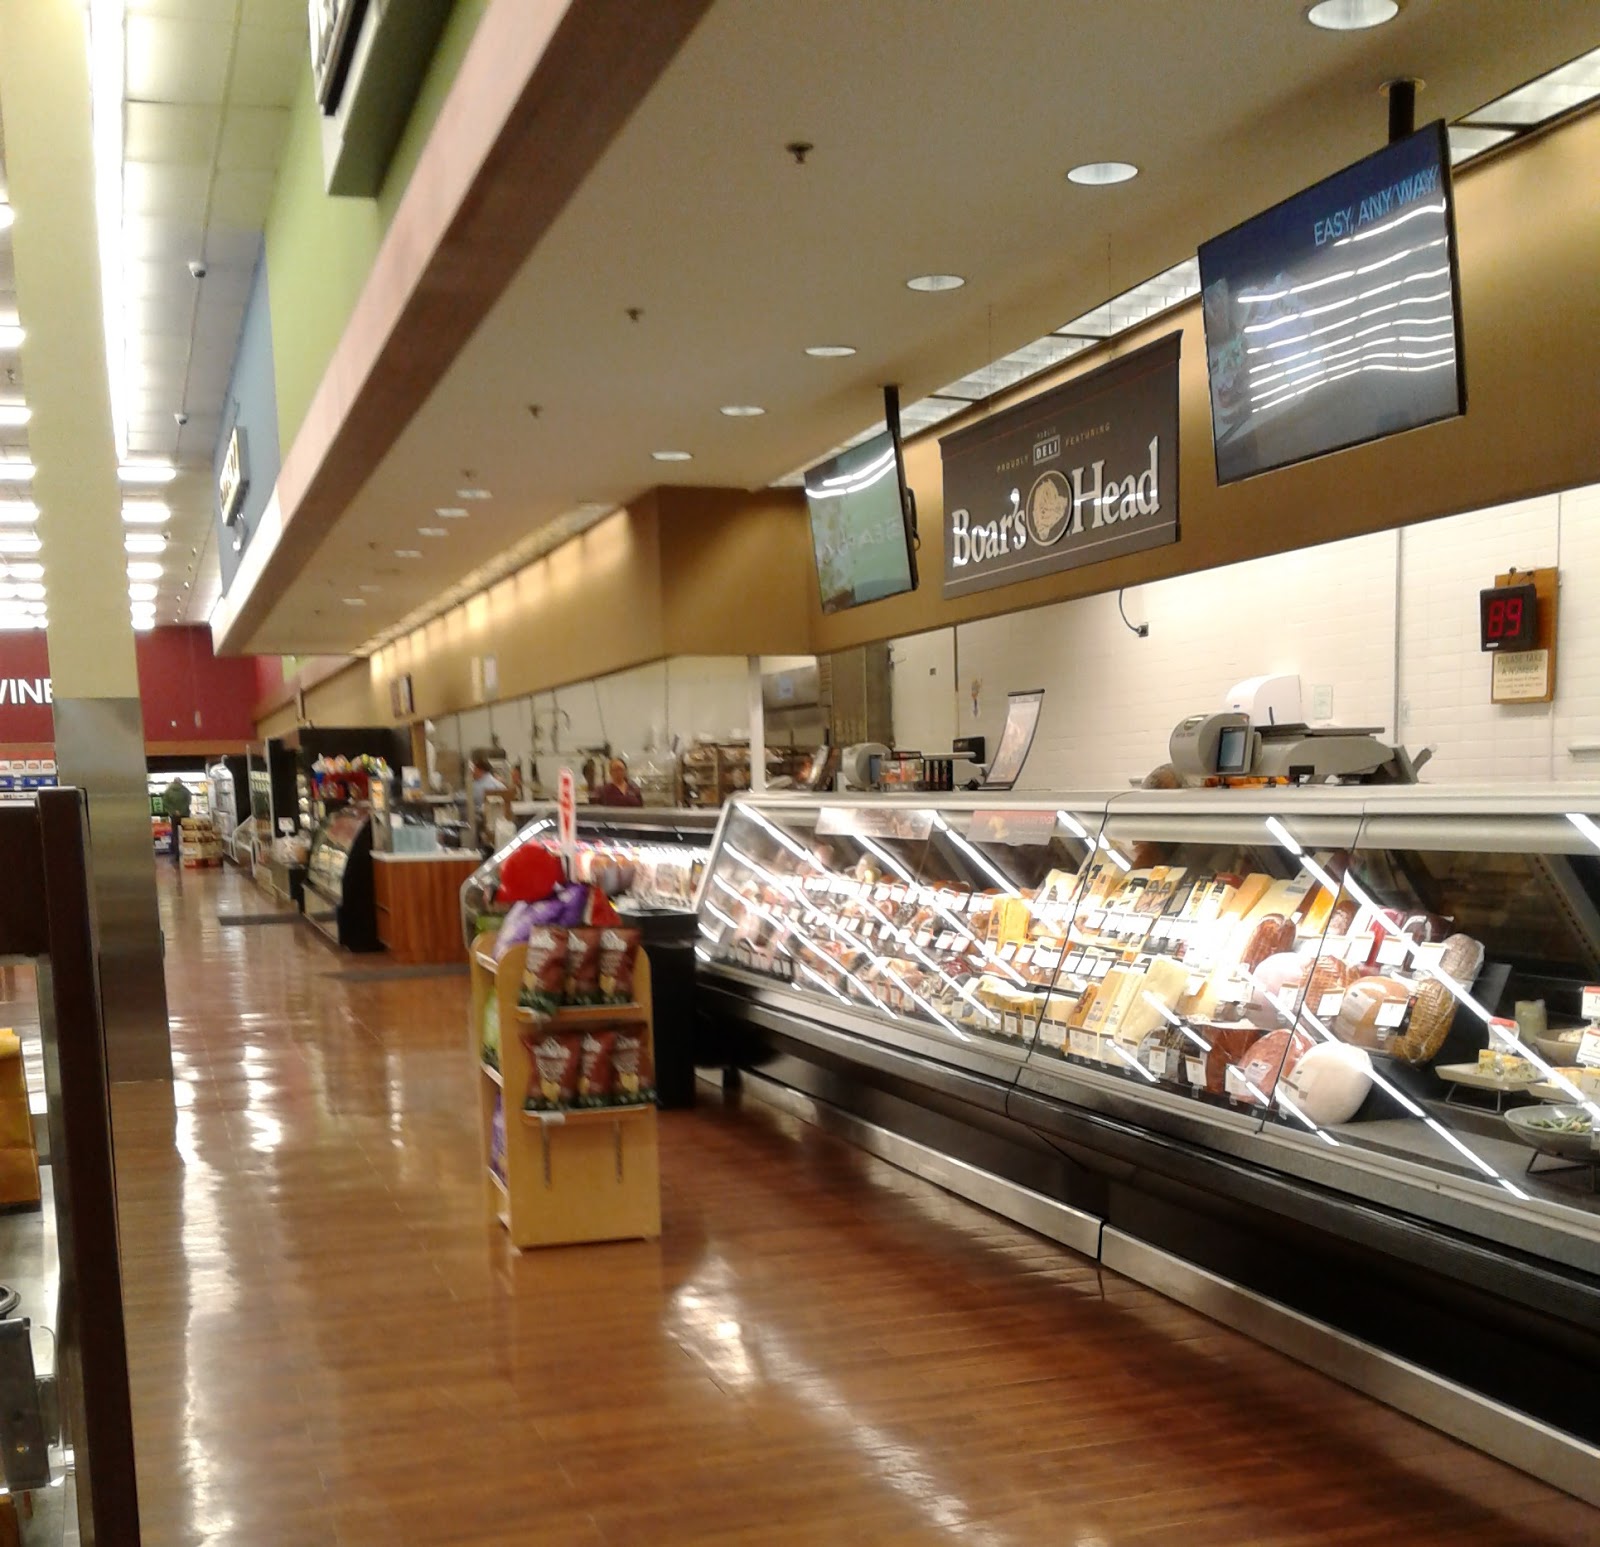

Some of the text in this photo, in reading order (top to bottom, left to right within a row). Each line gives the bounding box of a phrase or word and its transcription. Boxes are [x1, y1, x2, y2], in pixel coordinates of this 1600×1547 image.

[1313, 205, 1355, 246] EASY,
[1035, 440, 1058, 460] DELI
[951, 487, 1028, 568] Boar's
[1071, 435, 1161, 536] Head
[1487, 597, 1524, 638] 89
[0, 678, 53, 704] INE
